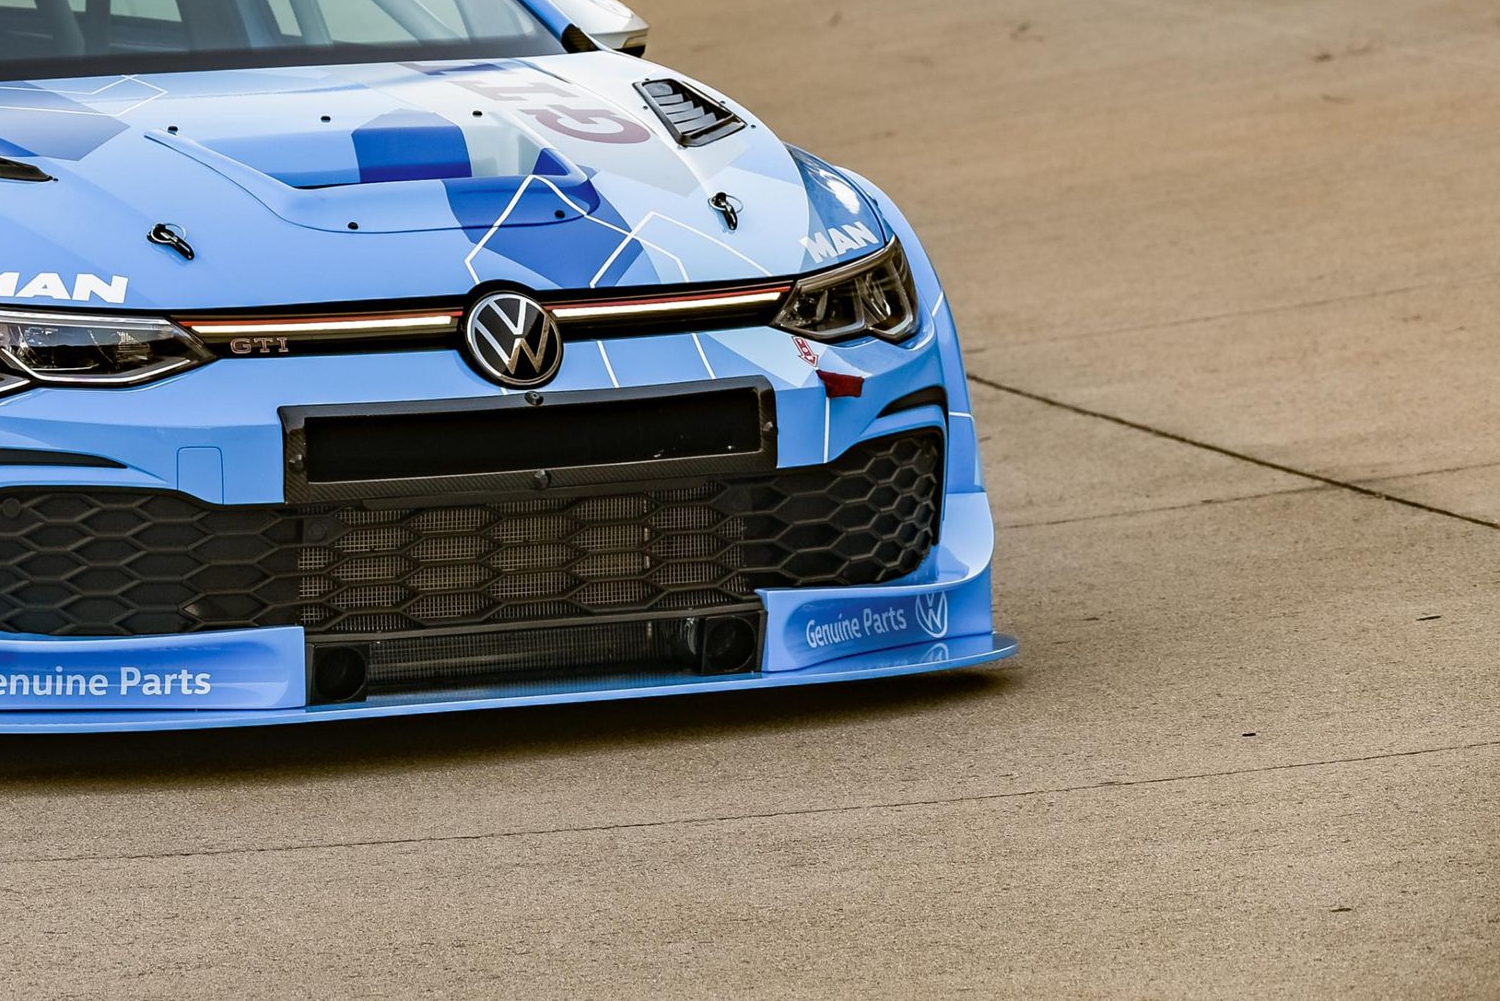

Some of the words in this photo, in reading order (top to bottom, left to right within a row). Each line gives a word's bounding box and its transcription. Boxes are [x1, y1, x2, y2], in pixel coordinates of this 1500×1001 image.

[798, 221, 879, 264] MAN
[230, 337, 289, 354] GTI
[806, 613, 861, 649] Genuine
[863, 607, 907, 636] Parts
[120, 666, 211, 696] Parts
